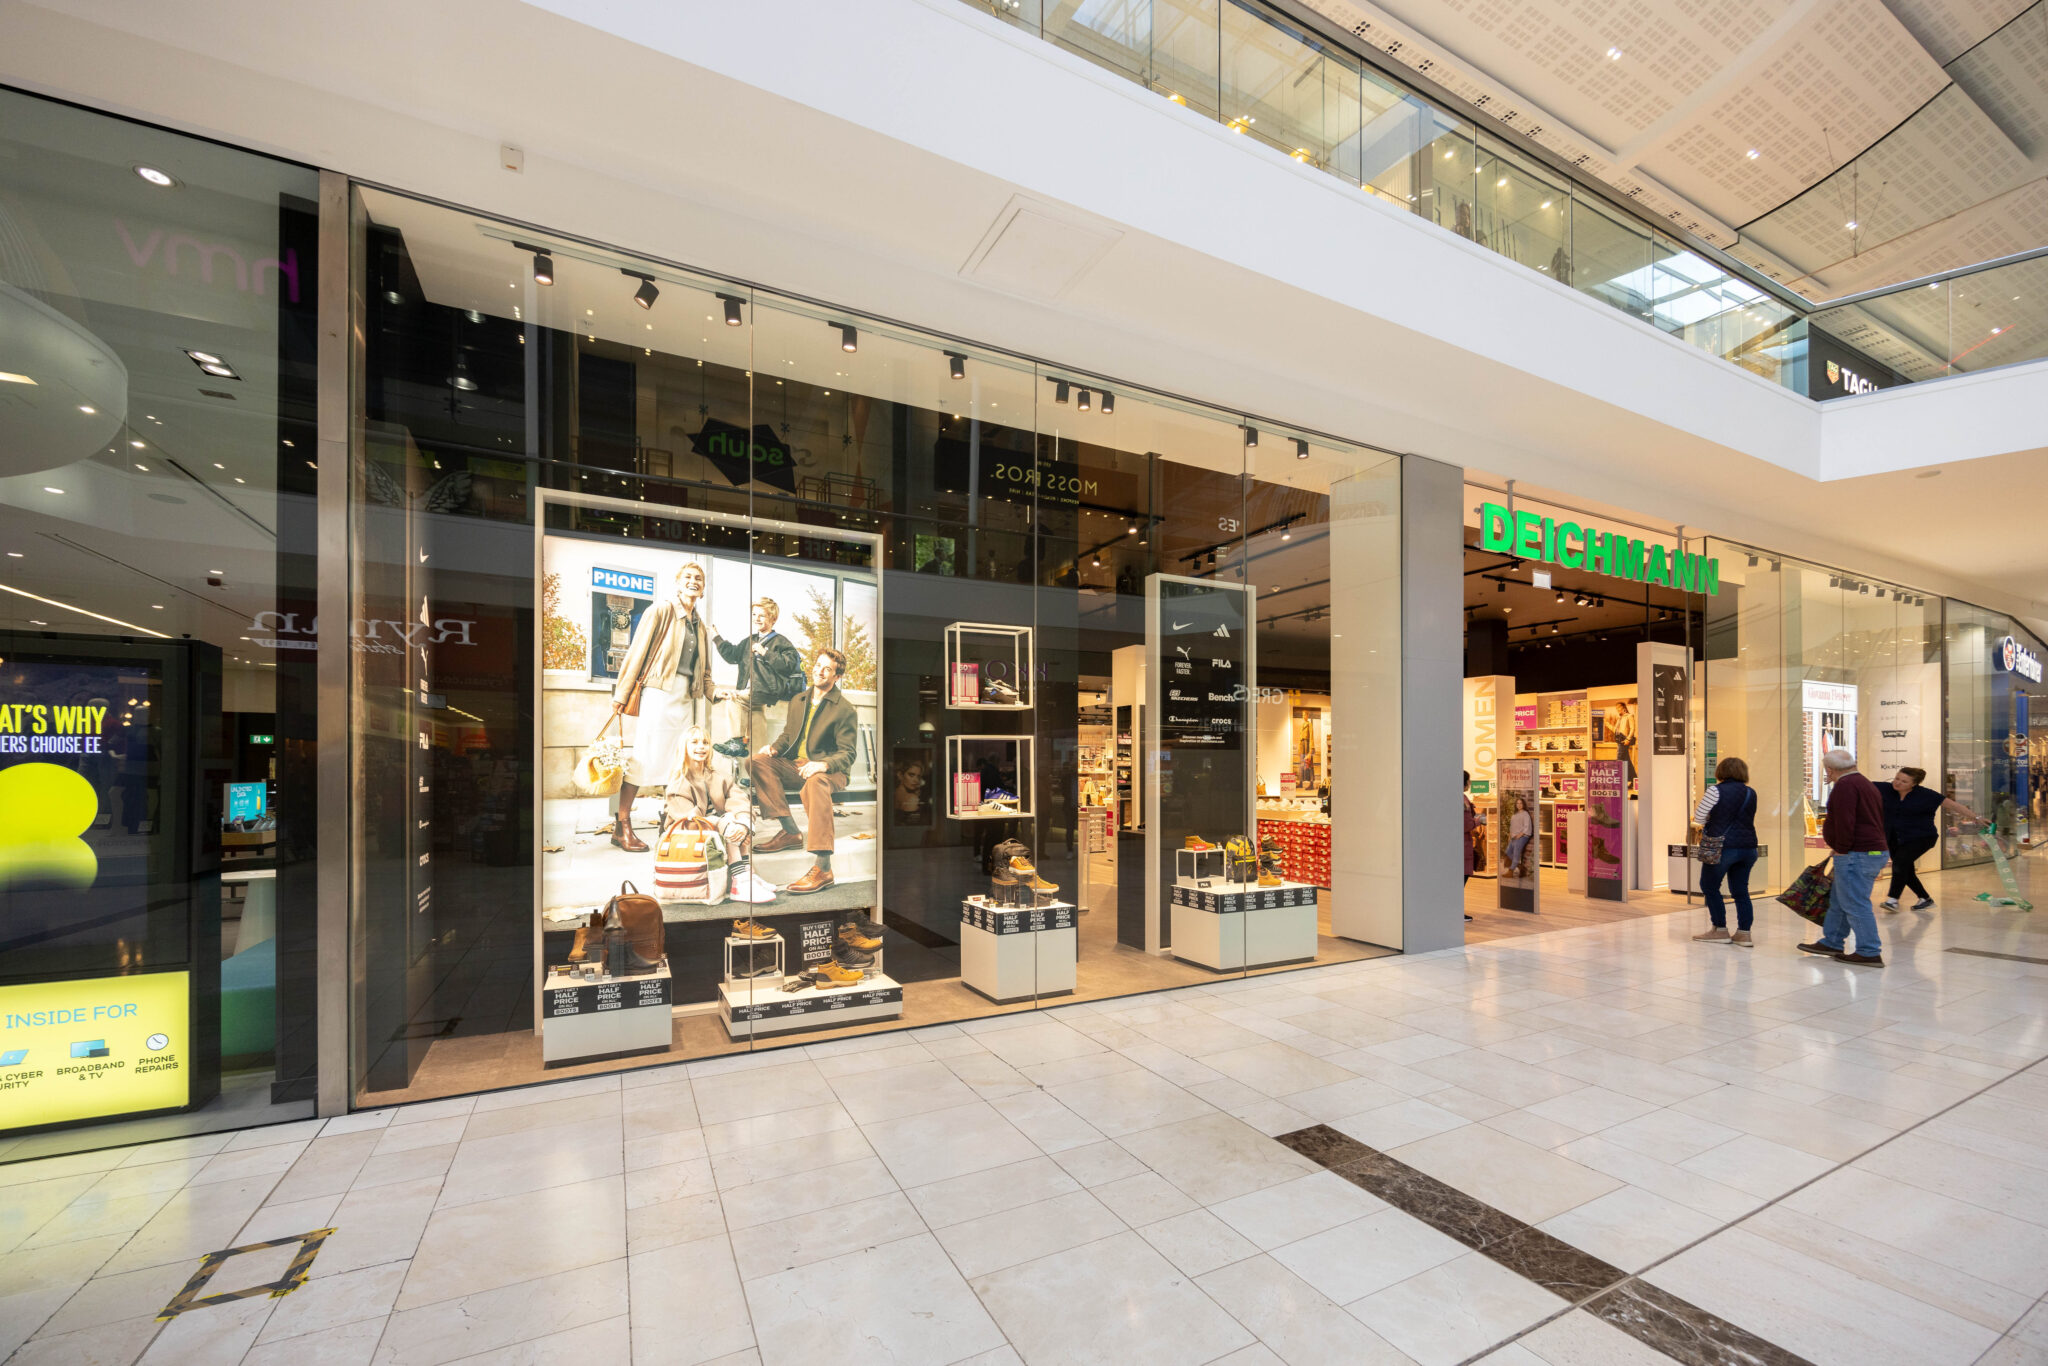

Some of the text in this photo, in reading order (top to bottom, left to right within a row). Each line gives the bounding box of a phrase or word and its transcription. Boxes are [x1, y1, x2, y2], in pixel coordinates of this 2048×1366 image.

[1481, 502, 1719, 596] DEICHMANN
[594, 571, 653, 592] PHONE
[1212, 659, 1231, 668] FILA
[53, 705, 107, 734] WHY
[31, 735, 82, 753] CHOOSE
[85, 736, 102, 753] EE
[1592, 769, 1619, 777] HALF
[1590, 777, 1621, 785] PRICE
[804, 928, 830, 939] HALF
[802, 936, 832, 947] PRICE
[806, 951, 831, 959] BOOTS
[554, 997, 579, 1005] PRICE
[6, 1003, 138, 1029] INSIDE FOR
[139, 1054, 176, 1065] PHONE
[57, 1061, 125, 1075] BROADBAND
[135, 1062, 179, 1074] REPAIRS
[6, 1070, 44, 1082] CYBER
[79, 1072, 104, 1081] & TV
